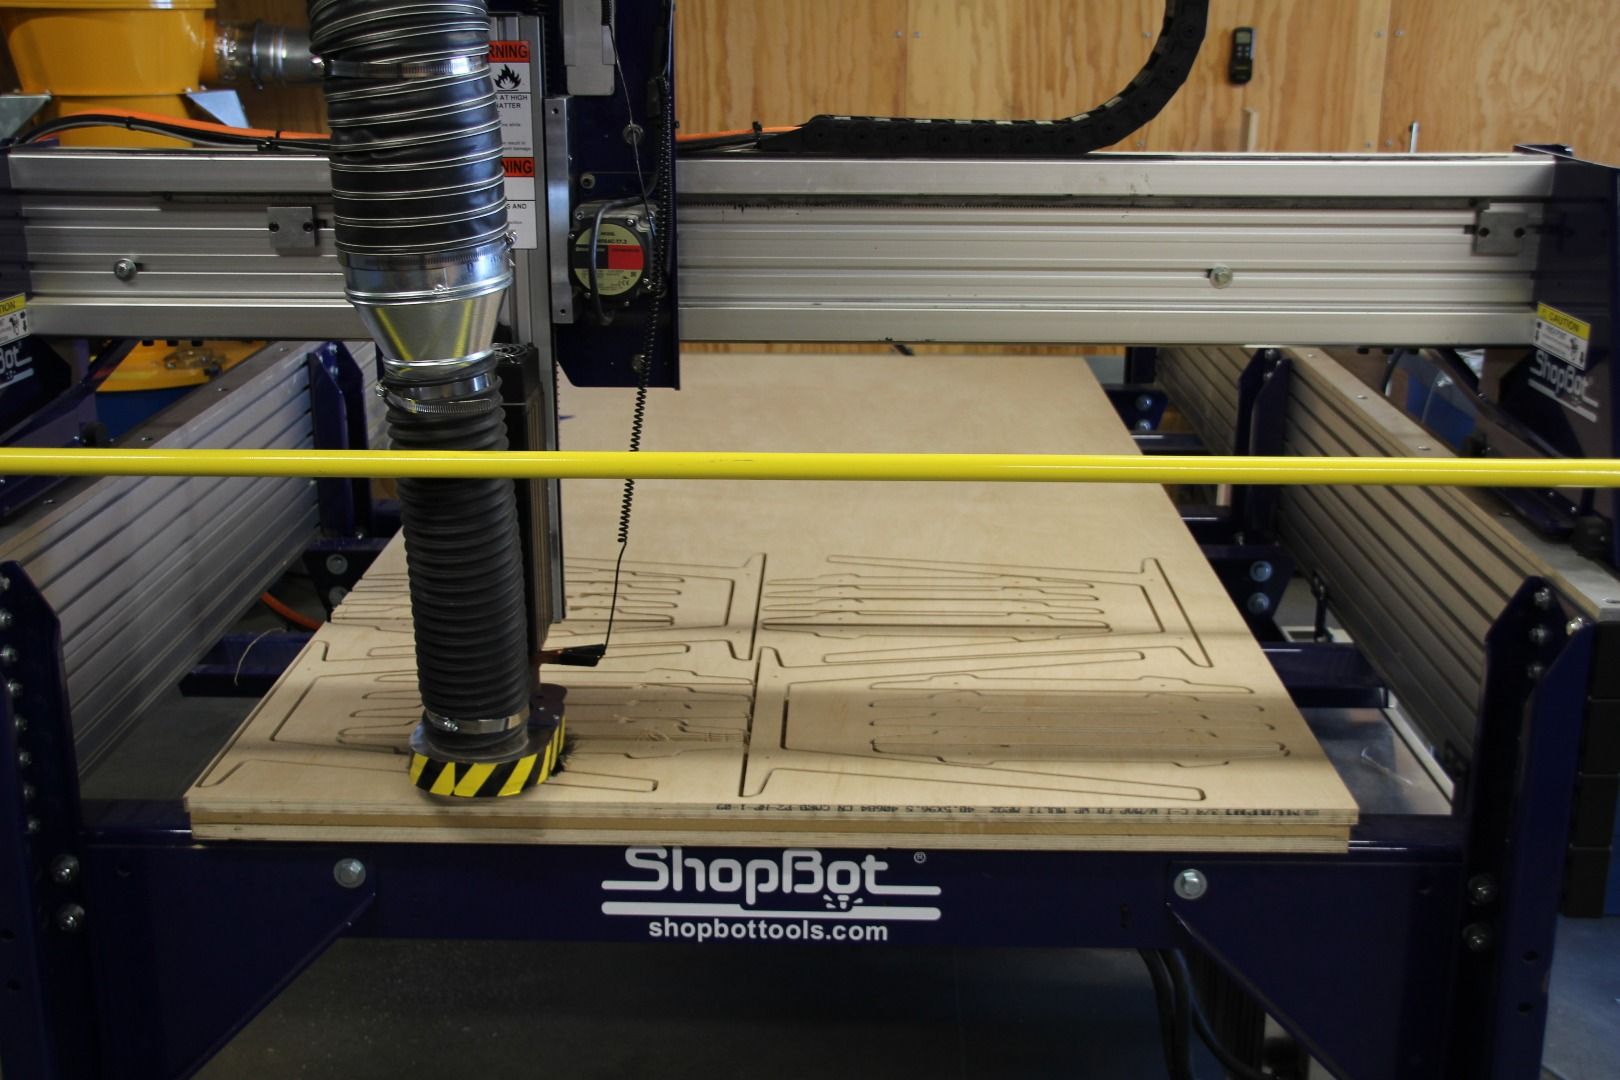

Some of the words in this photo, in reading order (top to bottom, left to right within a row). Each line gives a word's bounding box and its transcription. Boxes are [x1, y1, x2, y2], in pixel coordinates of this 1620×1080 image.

[490, 44, 527, 59] RNING
[1529, 349, 1600, 409] ShopBot
[601, 847, 942, 905] ShopBot
[649, 917, 888, 942] shopbottools.com
